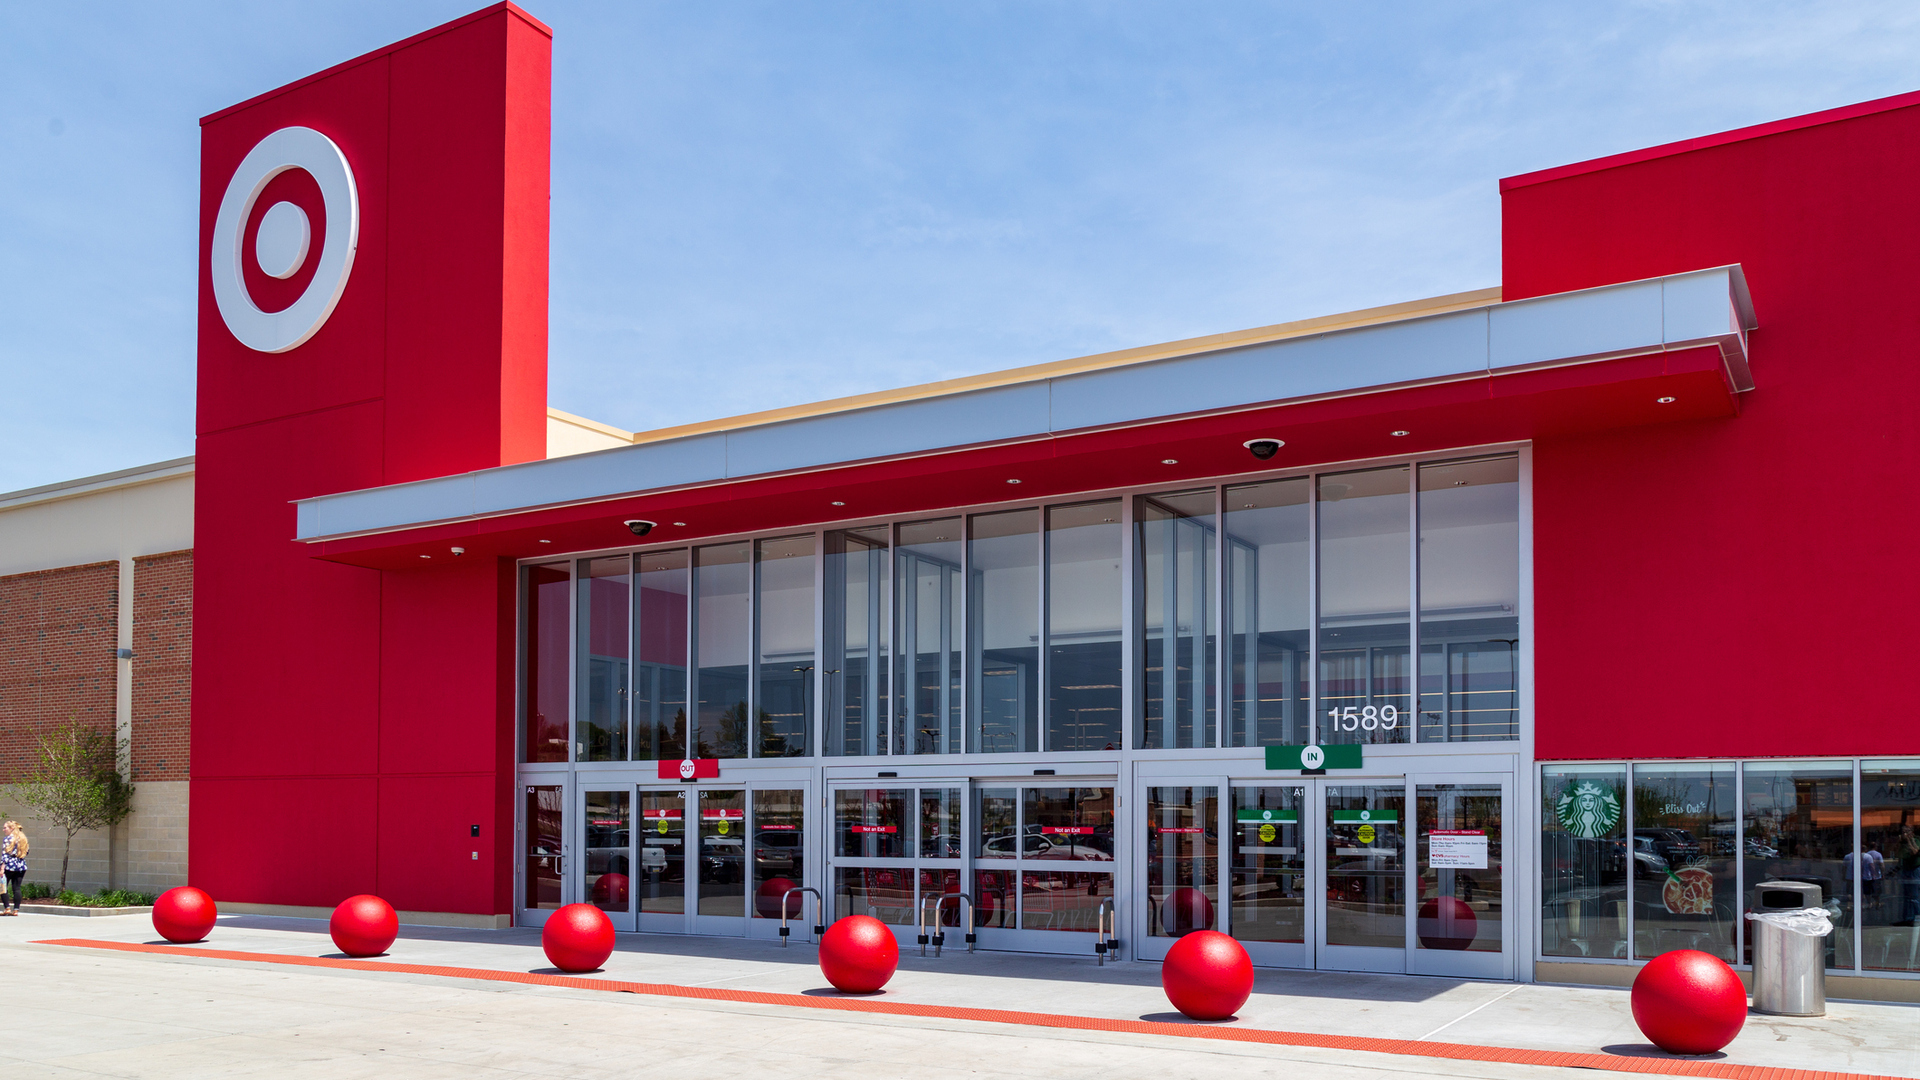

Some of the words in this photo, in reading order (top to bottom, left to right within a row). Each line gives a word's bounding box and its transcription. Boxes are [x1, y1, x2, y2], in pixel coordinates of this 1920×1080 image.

[1328, 704, 1398, 732] 1589
[1307, 752, 1318, 761] IN
[527, 786, 535, 794] A3
[1293, 788, 1304, 796] A1
[677, 791, 686, 799] A2
[1665, 803, 1684, 814] Bliss
[1686, 803, 1702, 814] Out
